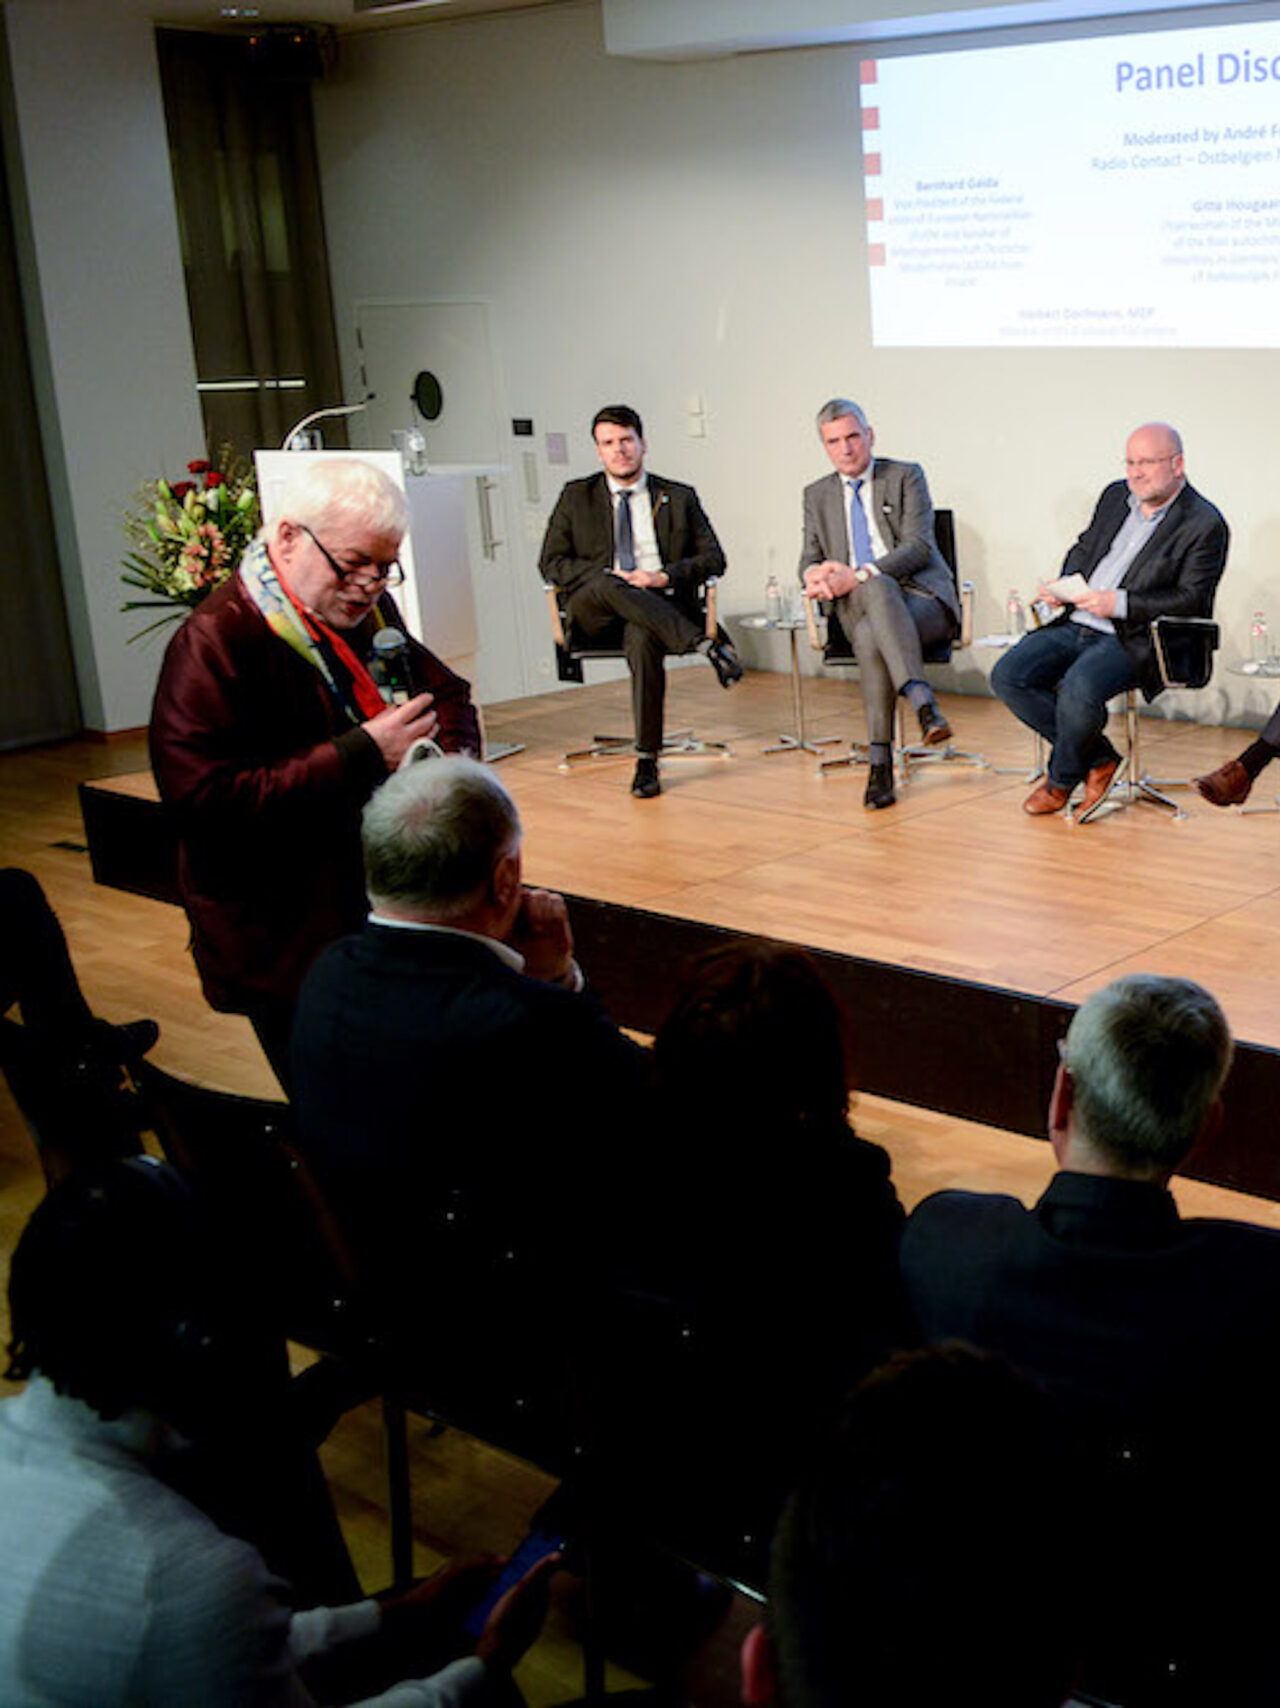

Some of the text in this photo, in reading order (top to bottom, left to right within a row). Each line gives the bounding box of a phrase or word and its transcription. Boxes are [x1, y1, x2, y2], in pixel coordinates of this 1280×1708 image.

[1115, 53, 1205, 93] Panel
[1123, 128, 1200, 147] Moderated
[1203, 127, 1220, 146] by
[1223, 122, 1267, 141] André
[1091, 155, 1128, 171] Radio
[1131, 152, 1182, 169] Contact
[1197, 148, 1273, 166] Ostbelgien
